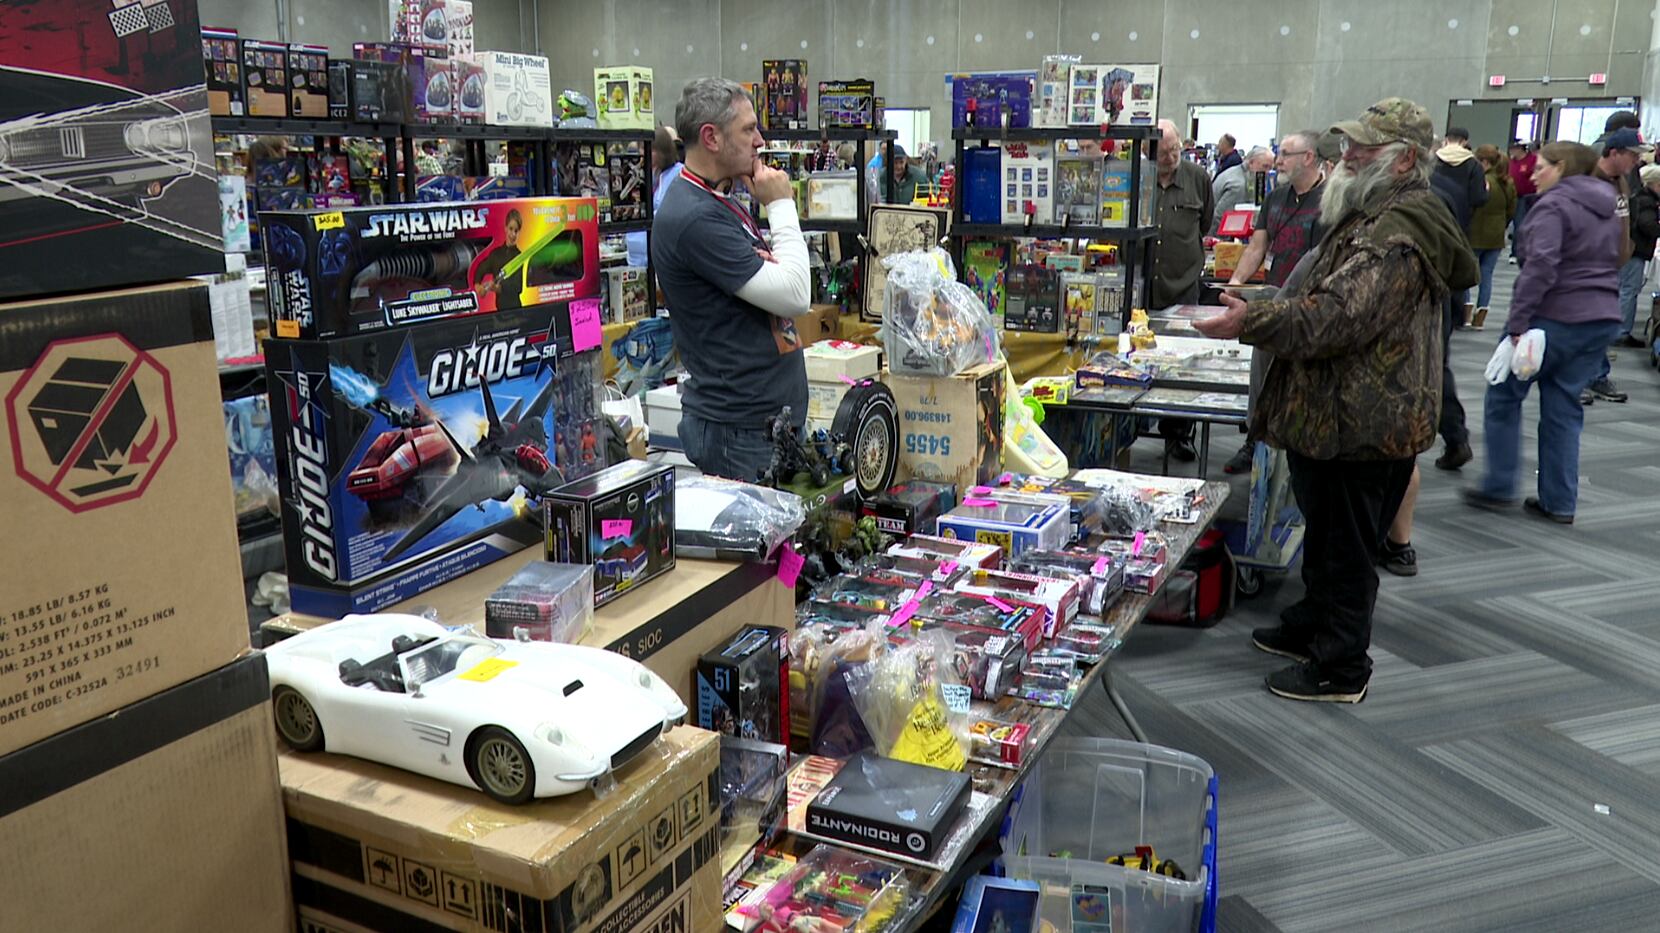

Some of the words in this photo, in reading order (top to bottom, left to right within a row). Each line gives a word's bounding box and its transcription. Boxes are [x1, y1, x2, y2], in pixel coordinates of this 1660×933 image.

[496, 54, 511, 64] Mini
[512, 55, 524, 68] Big
[524, 57, 545, 69] Wheel
[360, 212, 435, 239] STAR
[430, 208, 489, 233] WARS
[297, 271, 314, 329] STAR
[392, 308, 408, 319] LUKE
[407, 303, 441, 317] SKYWALKER
[441, 298, 473, 312] LIGHTSABER
[543, 344, 557, 359] 50
[297, 371, 310, 400] 50
[905, 433, 951, 457] 5455
[878, 519, 905, 531] TEAM
[12, 606, 42, 622] 18.85
[68, 589, 91, 604] 8.57
[95, 583, 109, 595] KG
[15, 621, 45, 637] 13.55
[71, 604, 94, 619] 6.16
[98, 599, 111, 610] KG
[19, 635, 50, 653] 2.538
[82, 616, 111, 631] 0.072
[22, 650, 53, 668] 23.25
[57, 645, 65, 656] X
[68, 631, 103, 652] 14.375
[106, 627, 113, 638] X
[117, 617, 149, 635] 13.125
[152, 607, 176, 622] INCH
[638, 628, 662, 655] SIOC
[25, 668, 45, 684] 591
[49, 663, 57, 674] X
[60, 656, 80, 672] 365
[83, 651, 91, 662] X
[94, 644, 113, 660] 333
[115, 636, 134, 651] MM
[116, 655, 161, 682] 32491
[0, 688, 29, 710] MADE
[33, 684, 46, 697] IN
[49, 671, 82, 691] CHINA
[714, 667, 731, 693] 51
[0, 708, 27, 726] DATE
[66, 677, 108, 701] C-3252A
[601, 890, 647, 933] COLLECTIBLE
